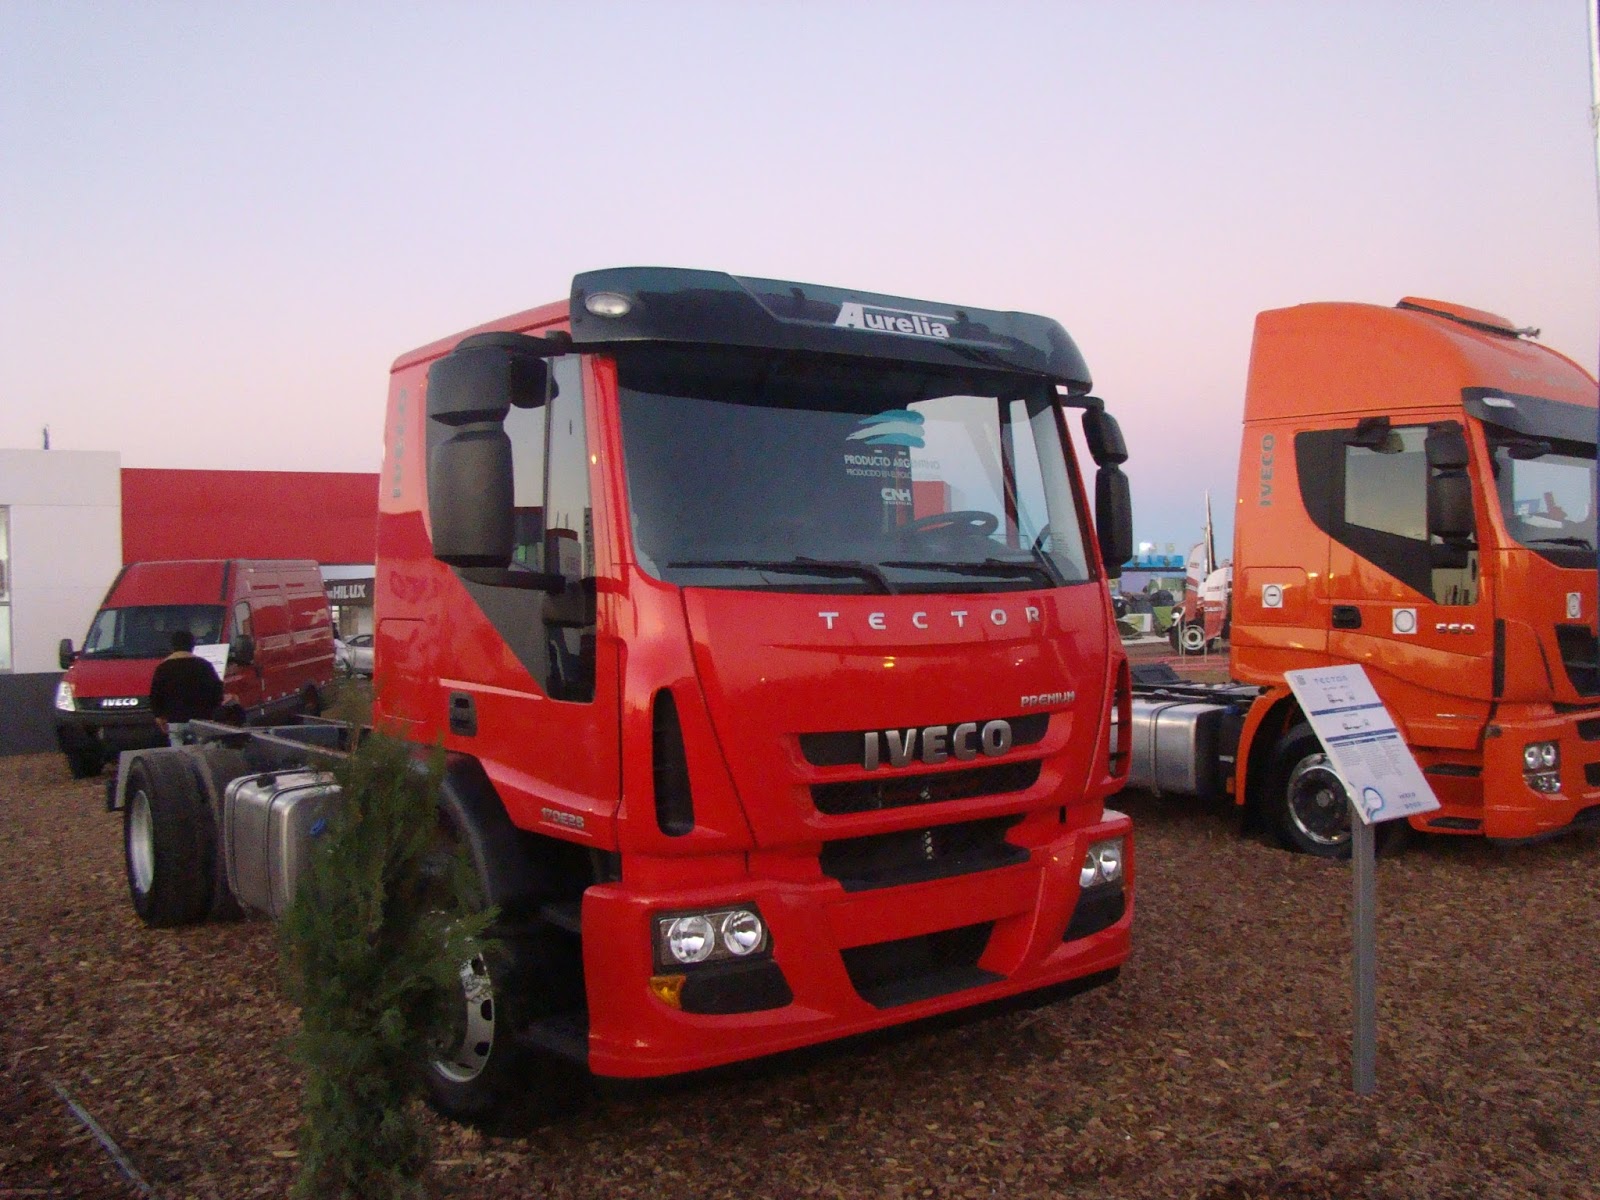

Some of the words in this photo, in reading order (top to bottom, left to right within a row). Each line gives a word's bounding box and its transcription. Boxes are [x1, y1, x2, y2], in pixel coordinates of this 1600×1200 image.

[835, 301, 950, 338] Aurelia
[844, 455, 891, 467] PRODUCTO
[1260, 434, 1275, 507] IVECO
[881, 488, 912, 501] CNH
[333, 584, 366, 599] HILUX
[818, 606, 1040, 630] TECTOR
[102, 698, 138, 706] IVECO
[1020, 691, 1075, 707] PREMIUM
[863, 719, 1012, 771] IVECO
